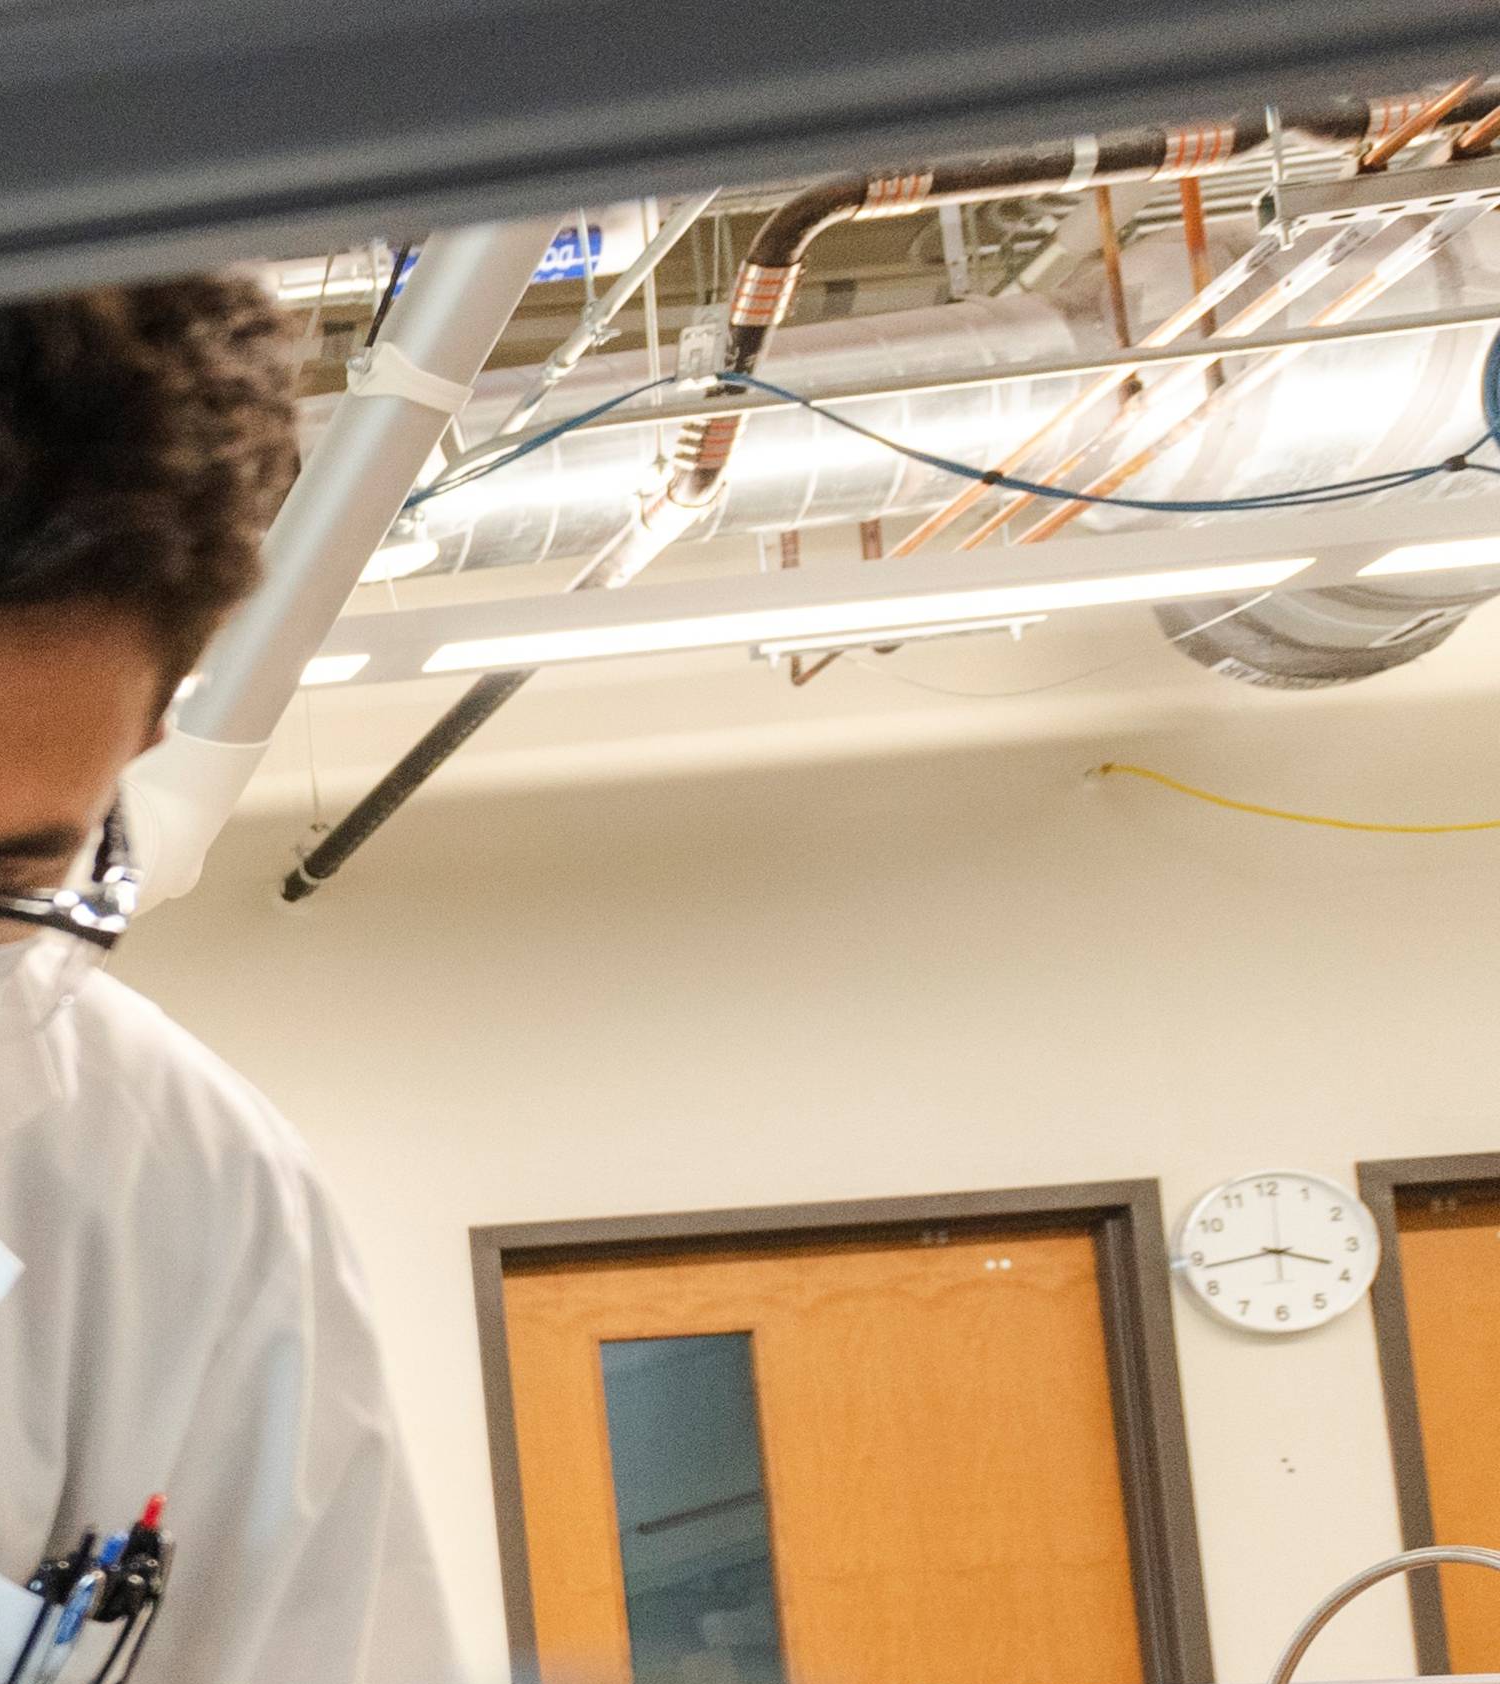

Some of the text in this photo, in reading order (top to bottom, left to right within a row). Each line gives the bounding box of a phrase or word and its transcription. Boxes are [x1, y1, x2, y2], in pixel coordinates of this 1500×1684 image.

[1255, 1183, 1278, 1196] 12
[1301, 1188, 1309, 1200] 1
[1223, 1195, 1243, 1208] 11
[1330, 1207, 1342, 1222] 2
[1199, 1218, 1224, 1232] 10
[1346, 1237, 1359, 1252] 3
[1191, 1252, 1204, 1265] 9
[1338, 1269, 1351, 1282] 4
[1207, 1281, 1220, 1295] 8
[1314, 1293, 1327, 1309] 5
[1238, 1301, 1250, 1316] 7
[1276, 1306, 1289, 1321] 6
